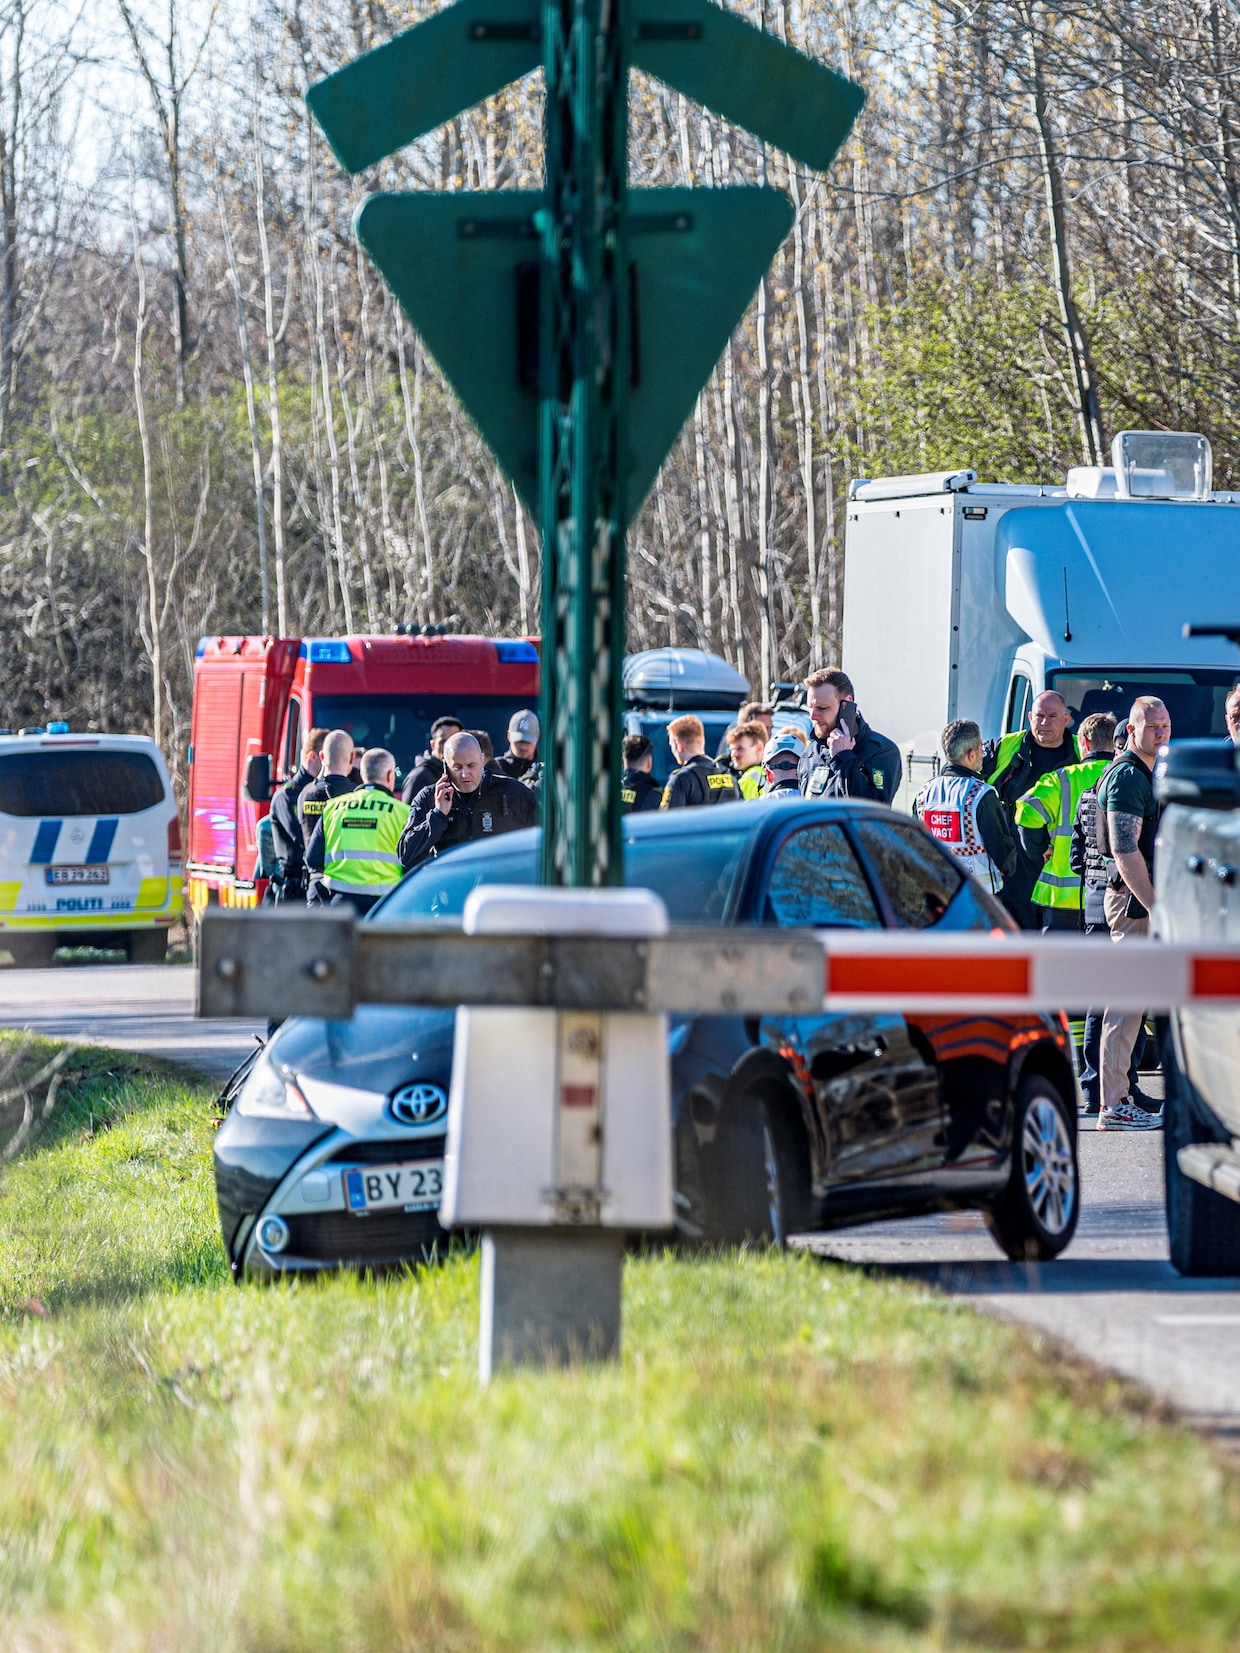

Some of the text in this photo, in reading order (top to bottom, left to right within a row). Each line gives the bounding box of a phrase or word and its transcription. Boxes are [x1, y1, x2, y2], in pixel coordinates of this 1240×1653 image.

[335, 799, 394, 814] POLITI
[930, 814, 952, 825] CHEF
[930, 827, 953, 838] VAGT
[56, 896, 103, 911] POLITI
[366, 1168, 443, 1202] BY 23
